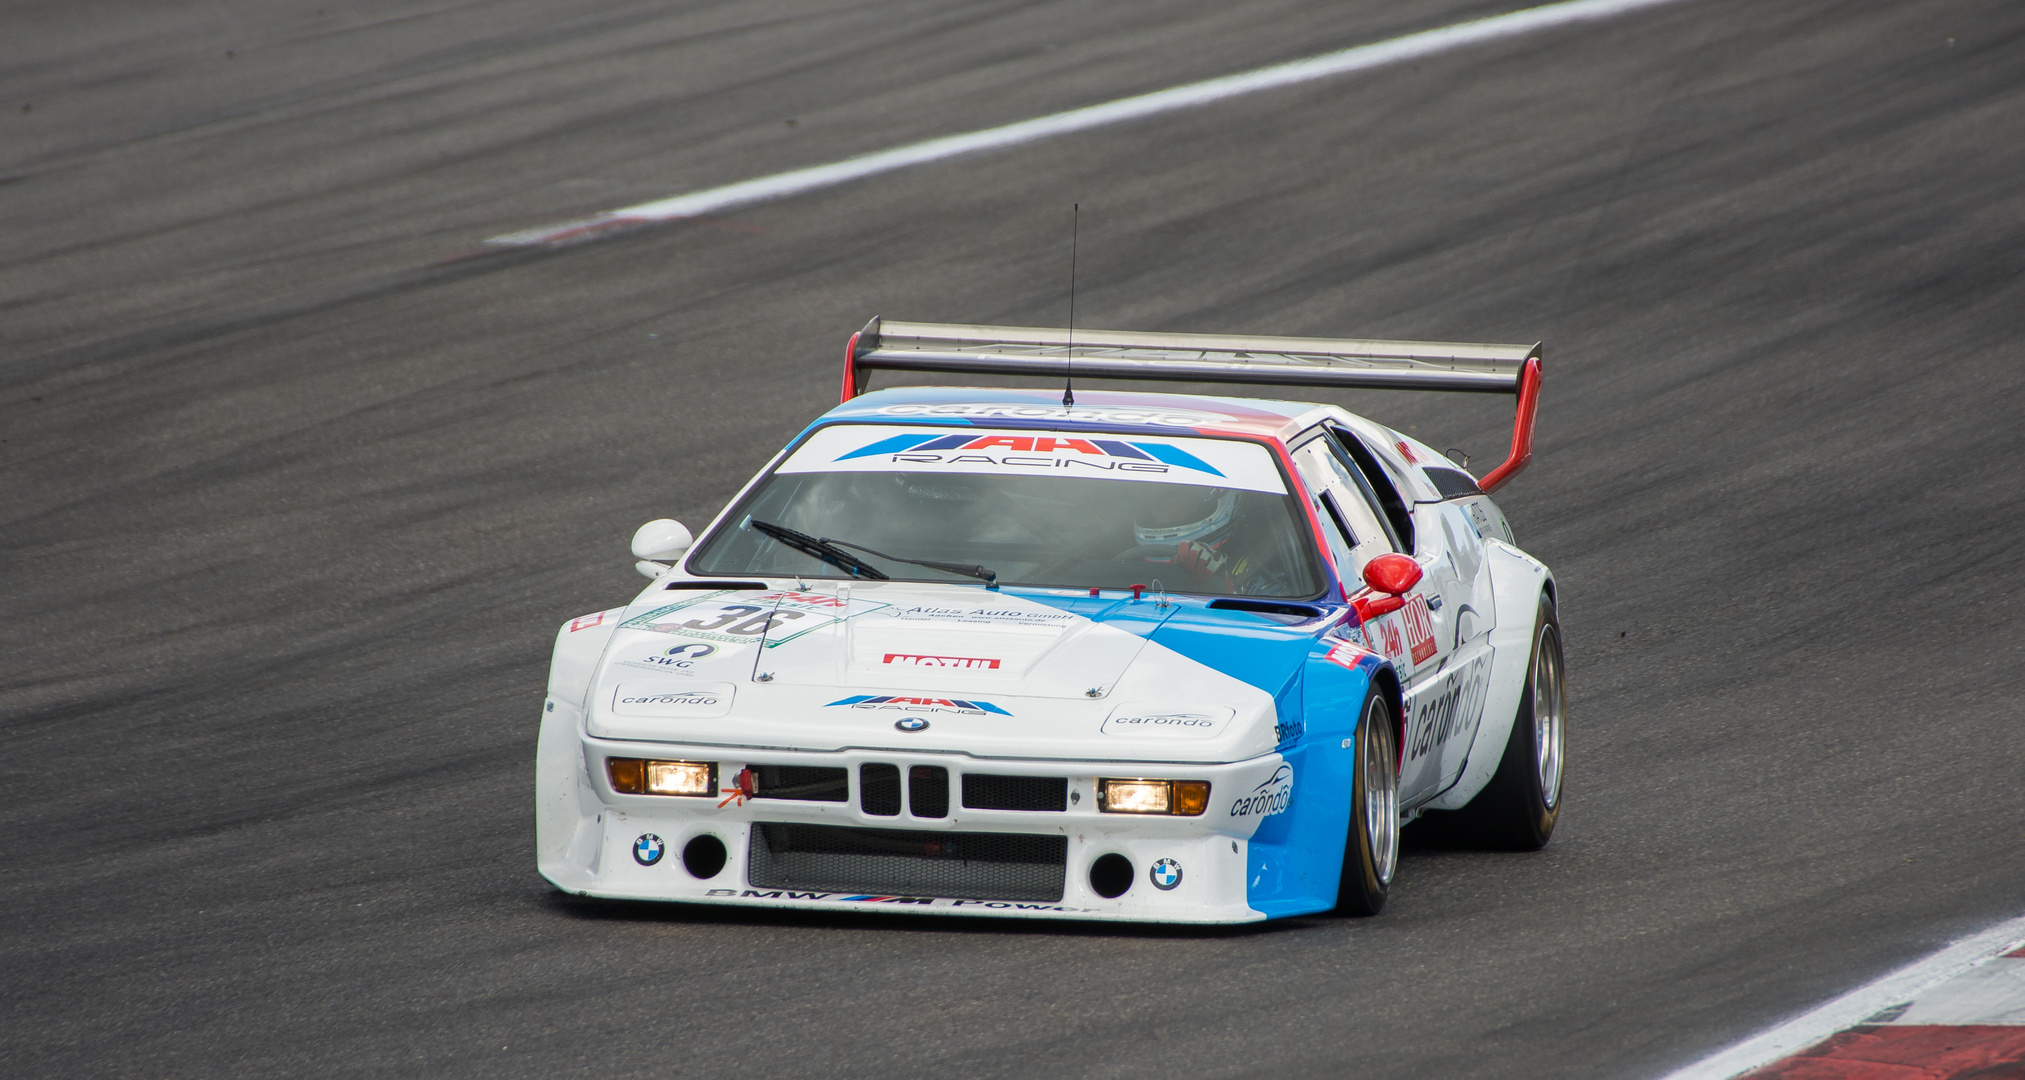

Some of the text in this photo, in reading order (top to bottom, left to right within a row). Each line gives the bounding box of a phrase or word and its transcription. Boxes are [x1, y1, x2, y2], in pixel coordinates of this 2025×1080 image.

[892, 453, 1169, 474] RACING
[907, 606, 1074, 620] Atlas Auto GmbH
[682, 605, 805, 635] 36
[643, 656, 694, 668] SWG
[622, 696, 718, 705] carondo
[851, 704, 987, 716] RACING
[1116, 718, 1212, 727] carondo
[704, 888, 833, 900] BMW
